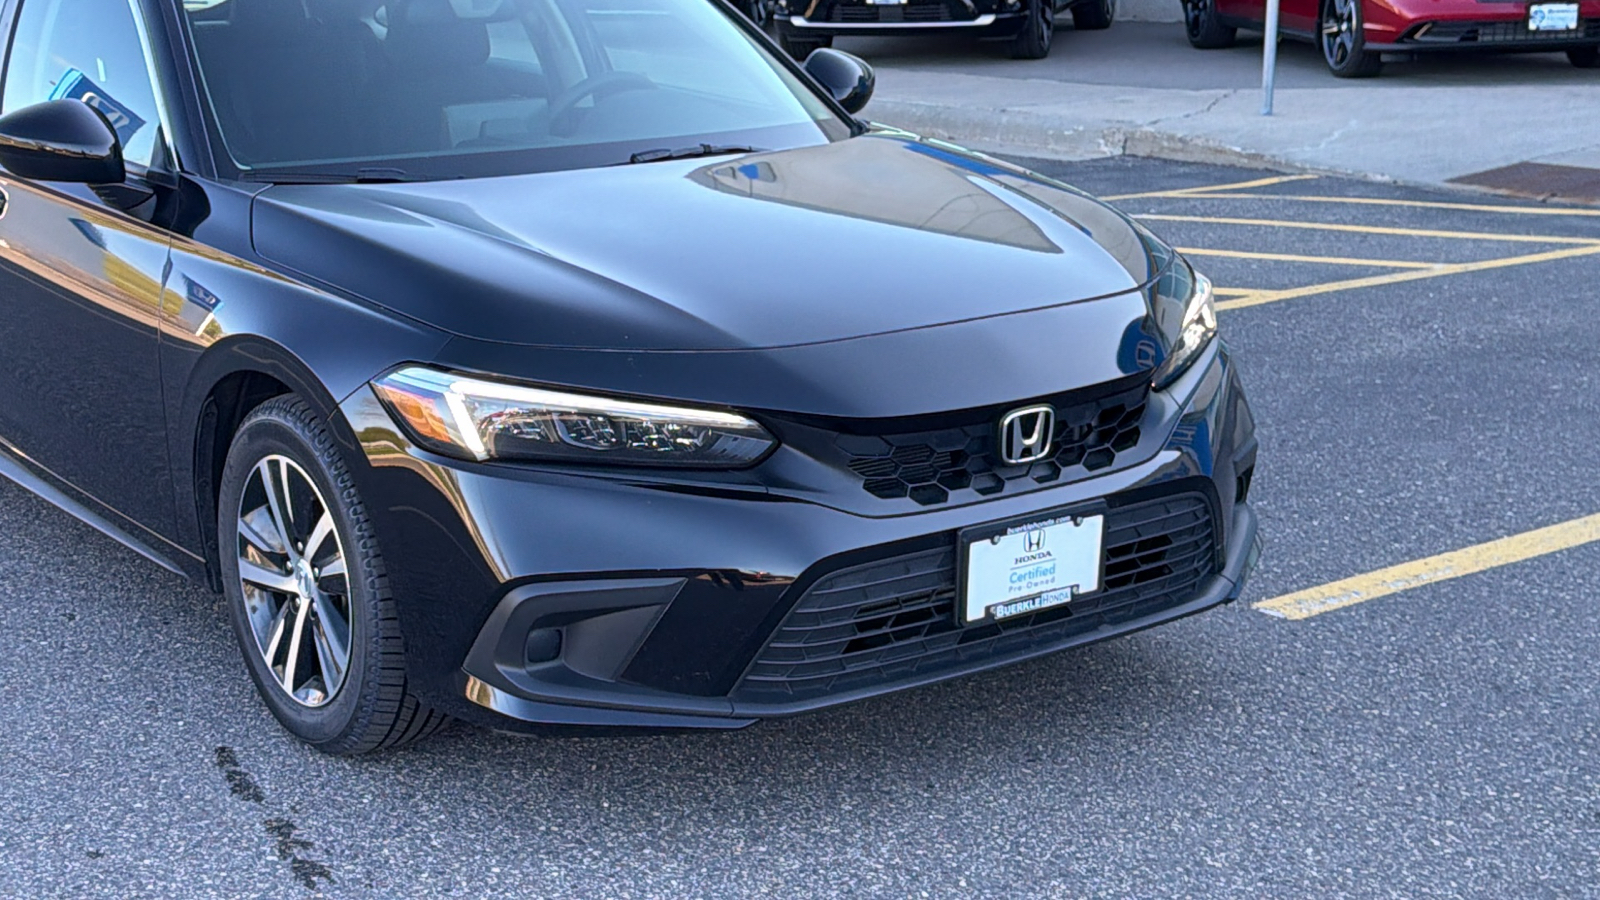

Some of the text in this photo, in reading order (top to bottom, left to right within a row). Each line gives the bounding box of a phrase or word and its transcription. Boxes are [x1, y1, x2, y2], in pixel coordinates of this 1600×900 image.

[1014, 551, 1053, 565] HONDA
[1009, 564, 1056, 584] Certified
[1008, 576, 1056, 593] Pre-Owned
